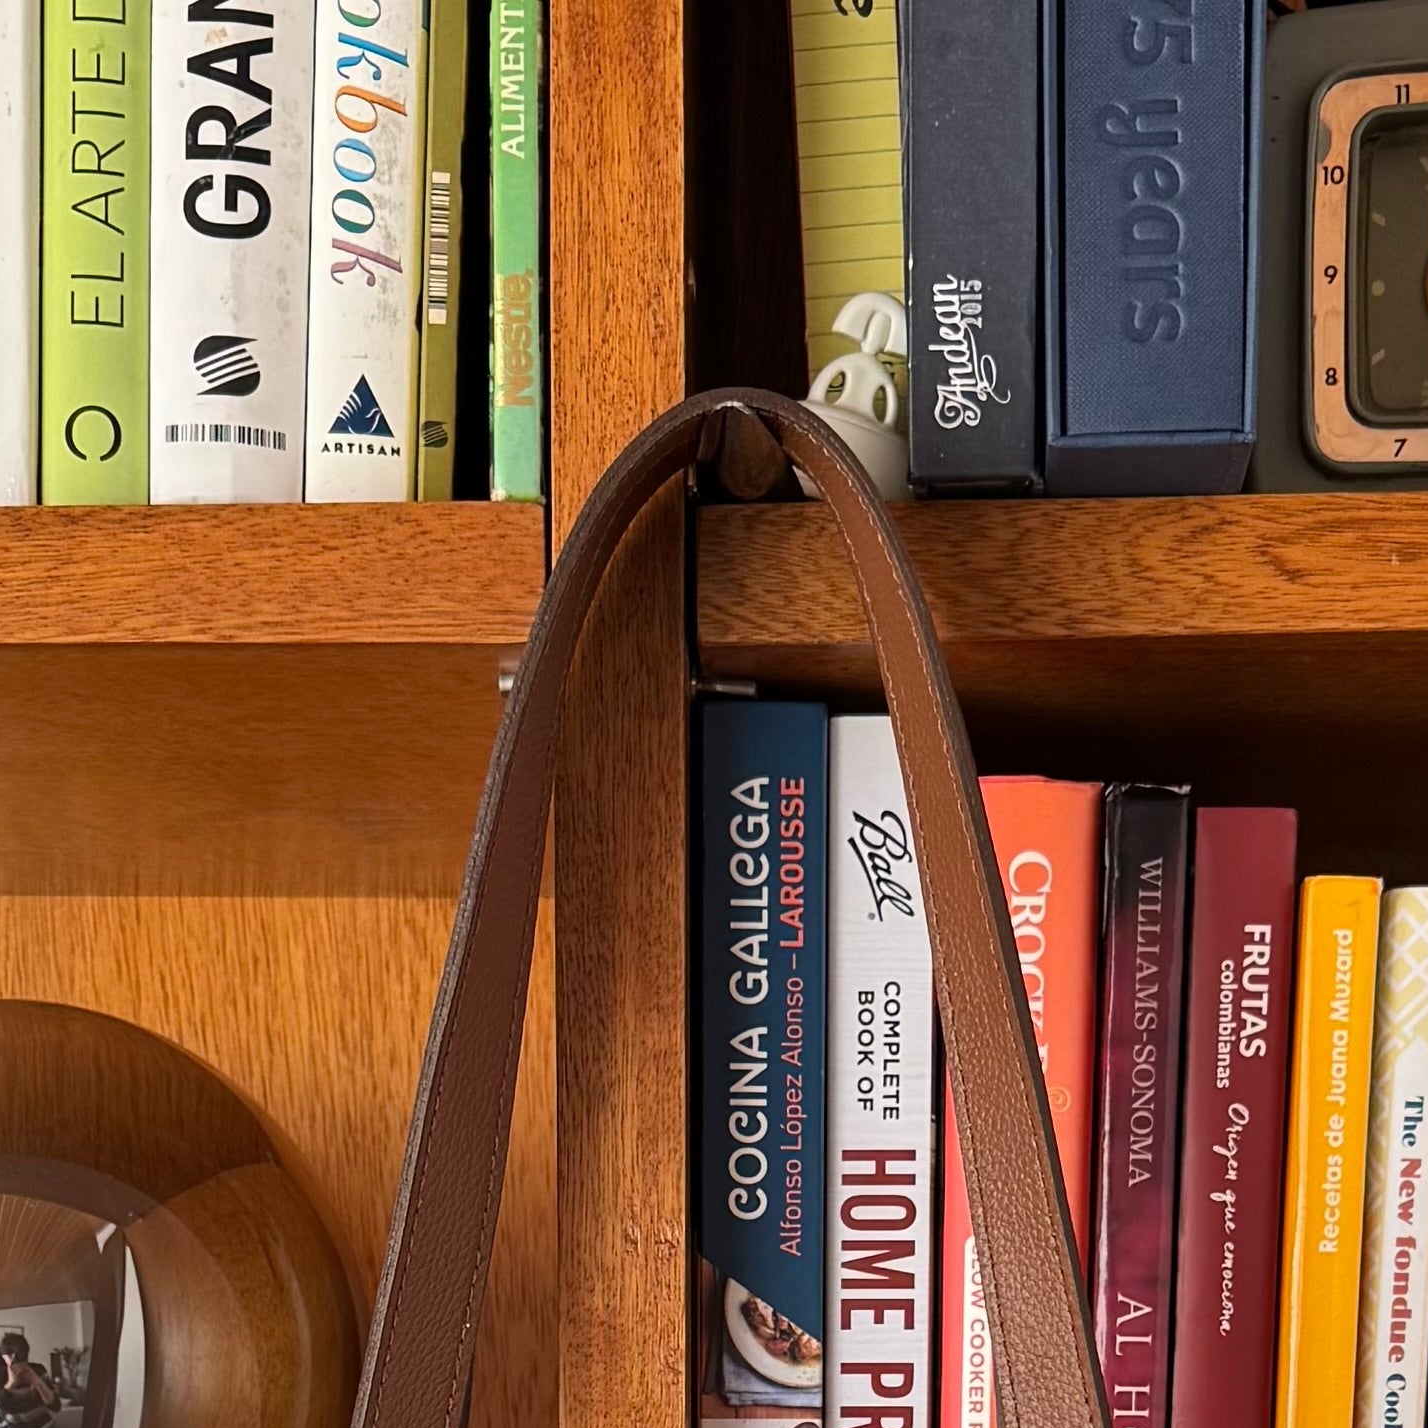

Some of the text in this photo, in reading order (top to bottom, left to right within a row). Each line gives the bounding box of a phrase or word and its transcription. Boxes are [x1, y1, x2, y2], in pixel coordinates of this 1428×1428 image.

[499, 0, 526, 159] ALIMENT
[1096, 97, 1185, 344] years
[1322, 165, 1345, 186] 10
[959, 279, 983, 328] 2015
[1323, 265, 1338, 285] 9
[928, 273, 1010, 429] Andean
[1324, 367, 1338, 387] 8
[320, 441, 401, 457] ARTISAN
[1393, 438, 1408, 459] 7
[849, 810, 915, 922] Ball
[780, 777, 809, 1257] Alfonso López Alonso LAROUSSE
[858, 991, 875, 1112] BOOK OF
[883, 981, 902, 1120] COMPLETE
[1128, 857, 1163, 1188] WILLIAMS-SONOMA
[1217, 959, 1236, 1089] colombianas
[1238, 924, 1273, 1059] FRUTAS
[728, 1026, 769, 1221] COCINA
[1318, 928, 1353, 1254] Recetas de Juana Muzard
[1401, 1095, 1424, 1148] The
[839, 1149, 917, 1331] HOME
[1210, 1103, 1250, 1337] Origen que emociona
[1397, 1157, 1423, 1226] New
[1115, 1292, 1152, 1356] AL
[1388, 1236, 1417, 1364] fondue
[968, 1319, 986, 1413] COOKER
